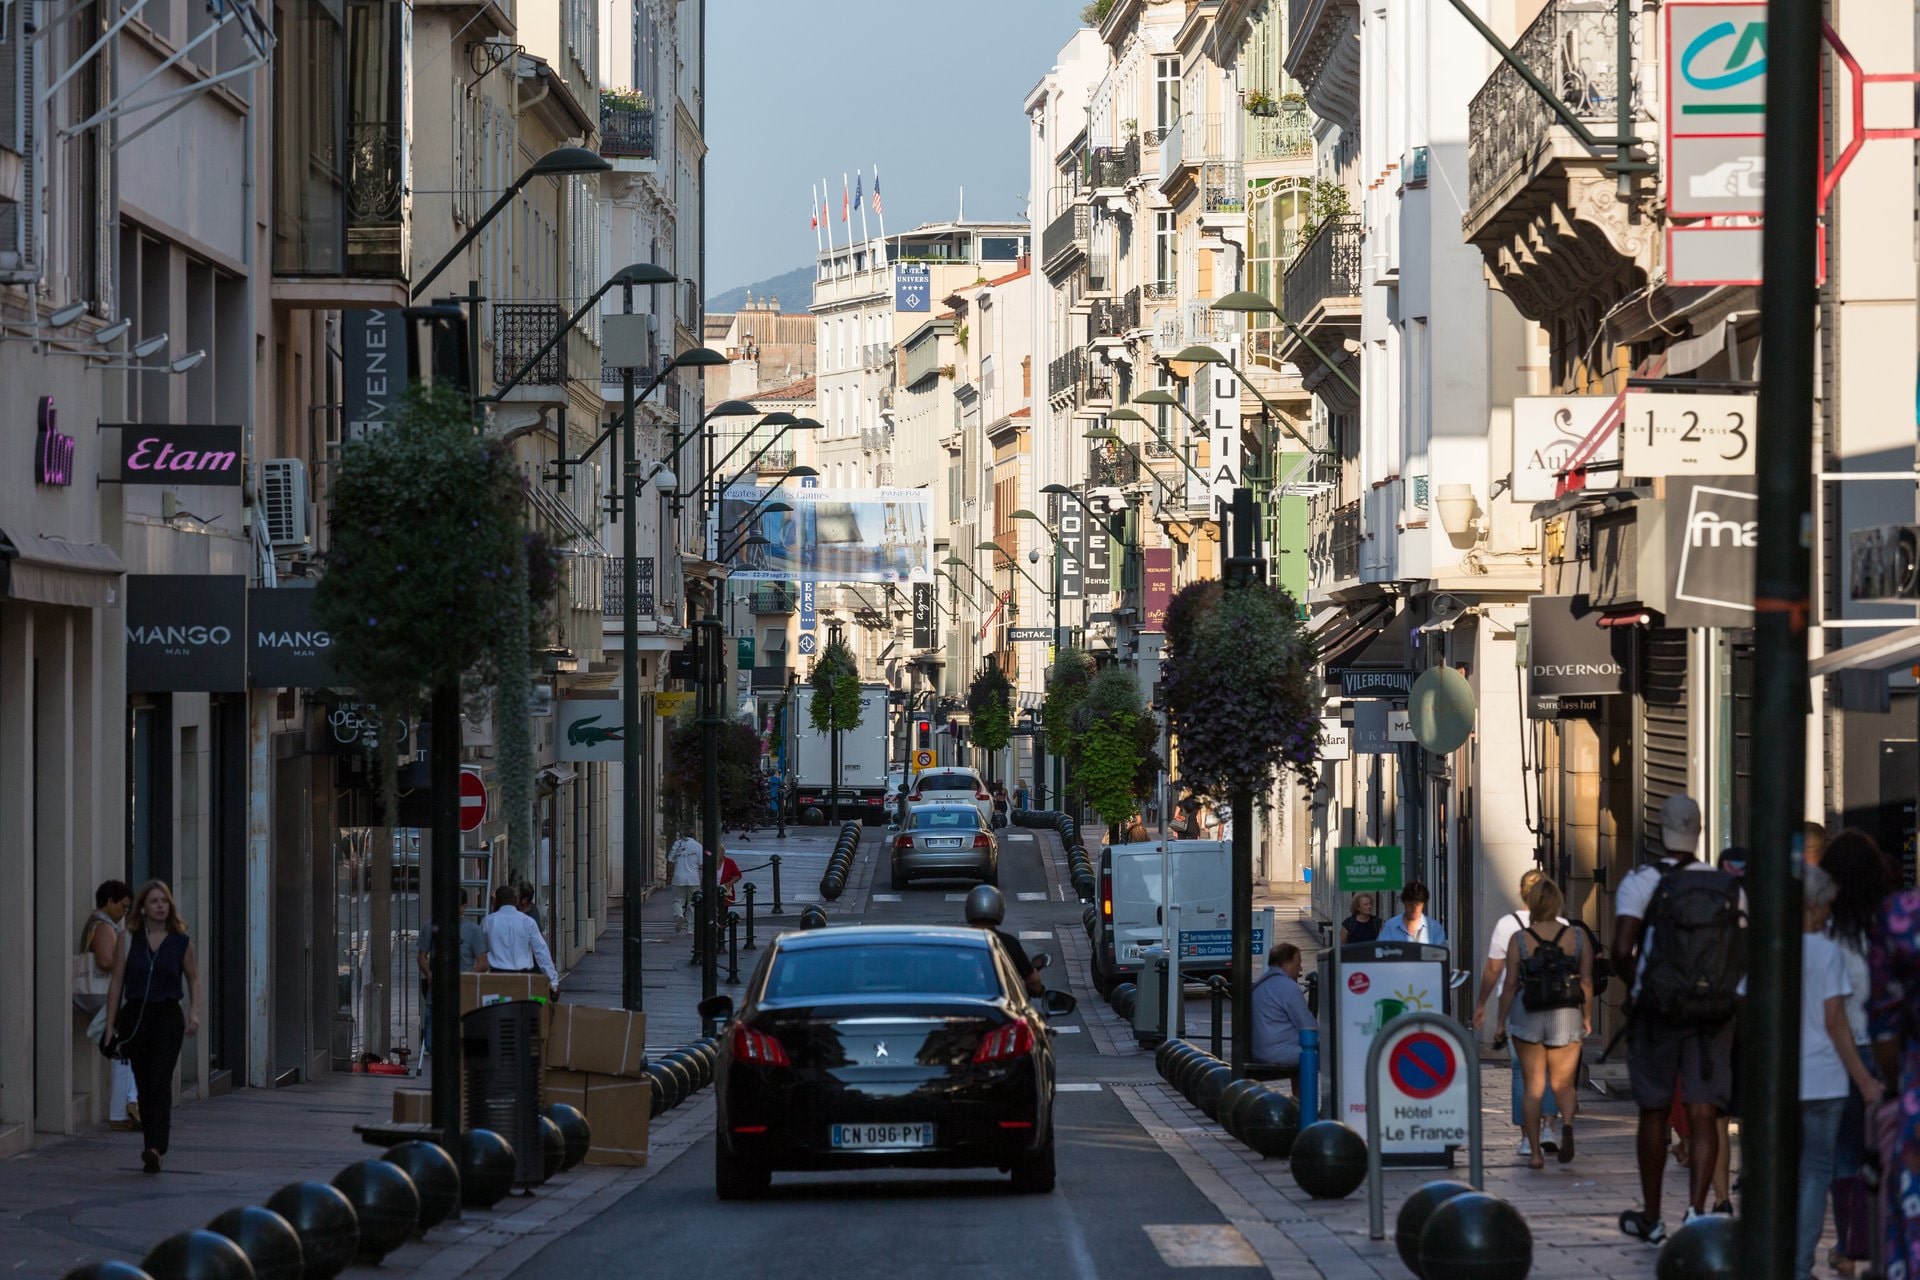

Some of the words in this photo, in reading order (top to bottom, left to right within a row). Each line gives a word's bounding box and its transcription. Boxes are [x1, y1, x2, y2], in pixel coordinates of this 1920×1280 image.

[1645, 410, 1654, 447] 1
[1680, 410, 1702, 442] 2
[1719, 411, 1749, 461] 3
[127, 437, 236, 471] Etam
[1089, 500, 1107, 569] OTEL
[1691, 511, 1758, 548] fna
[1062, 495, 1081, 596] HOTEL
[126, 626, 231, 645] MANGO
[257, 631, 331, 648] MANG
[165, 648, 191, 656] MAN
[1533, 663, 1626, 677] DEVERNOIS
[1345, 673, 1412, 696] VILEBREQUIN
[1537, 699, 1579, 711] sunglass
[1580, 699, 1597, 710] hut
[1353, 855, 1378, 865] SOLAR
[1345, 865, 1370, 875] TRASH
[1371, 865, 1387, 875] CAN
[1394, 1106, 1433, 1119] Hôtel
[1385, 1126, 1404, 1141] Le
[1411, 1125, 1465, 1140] France
